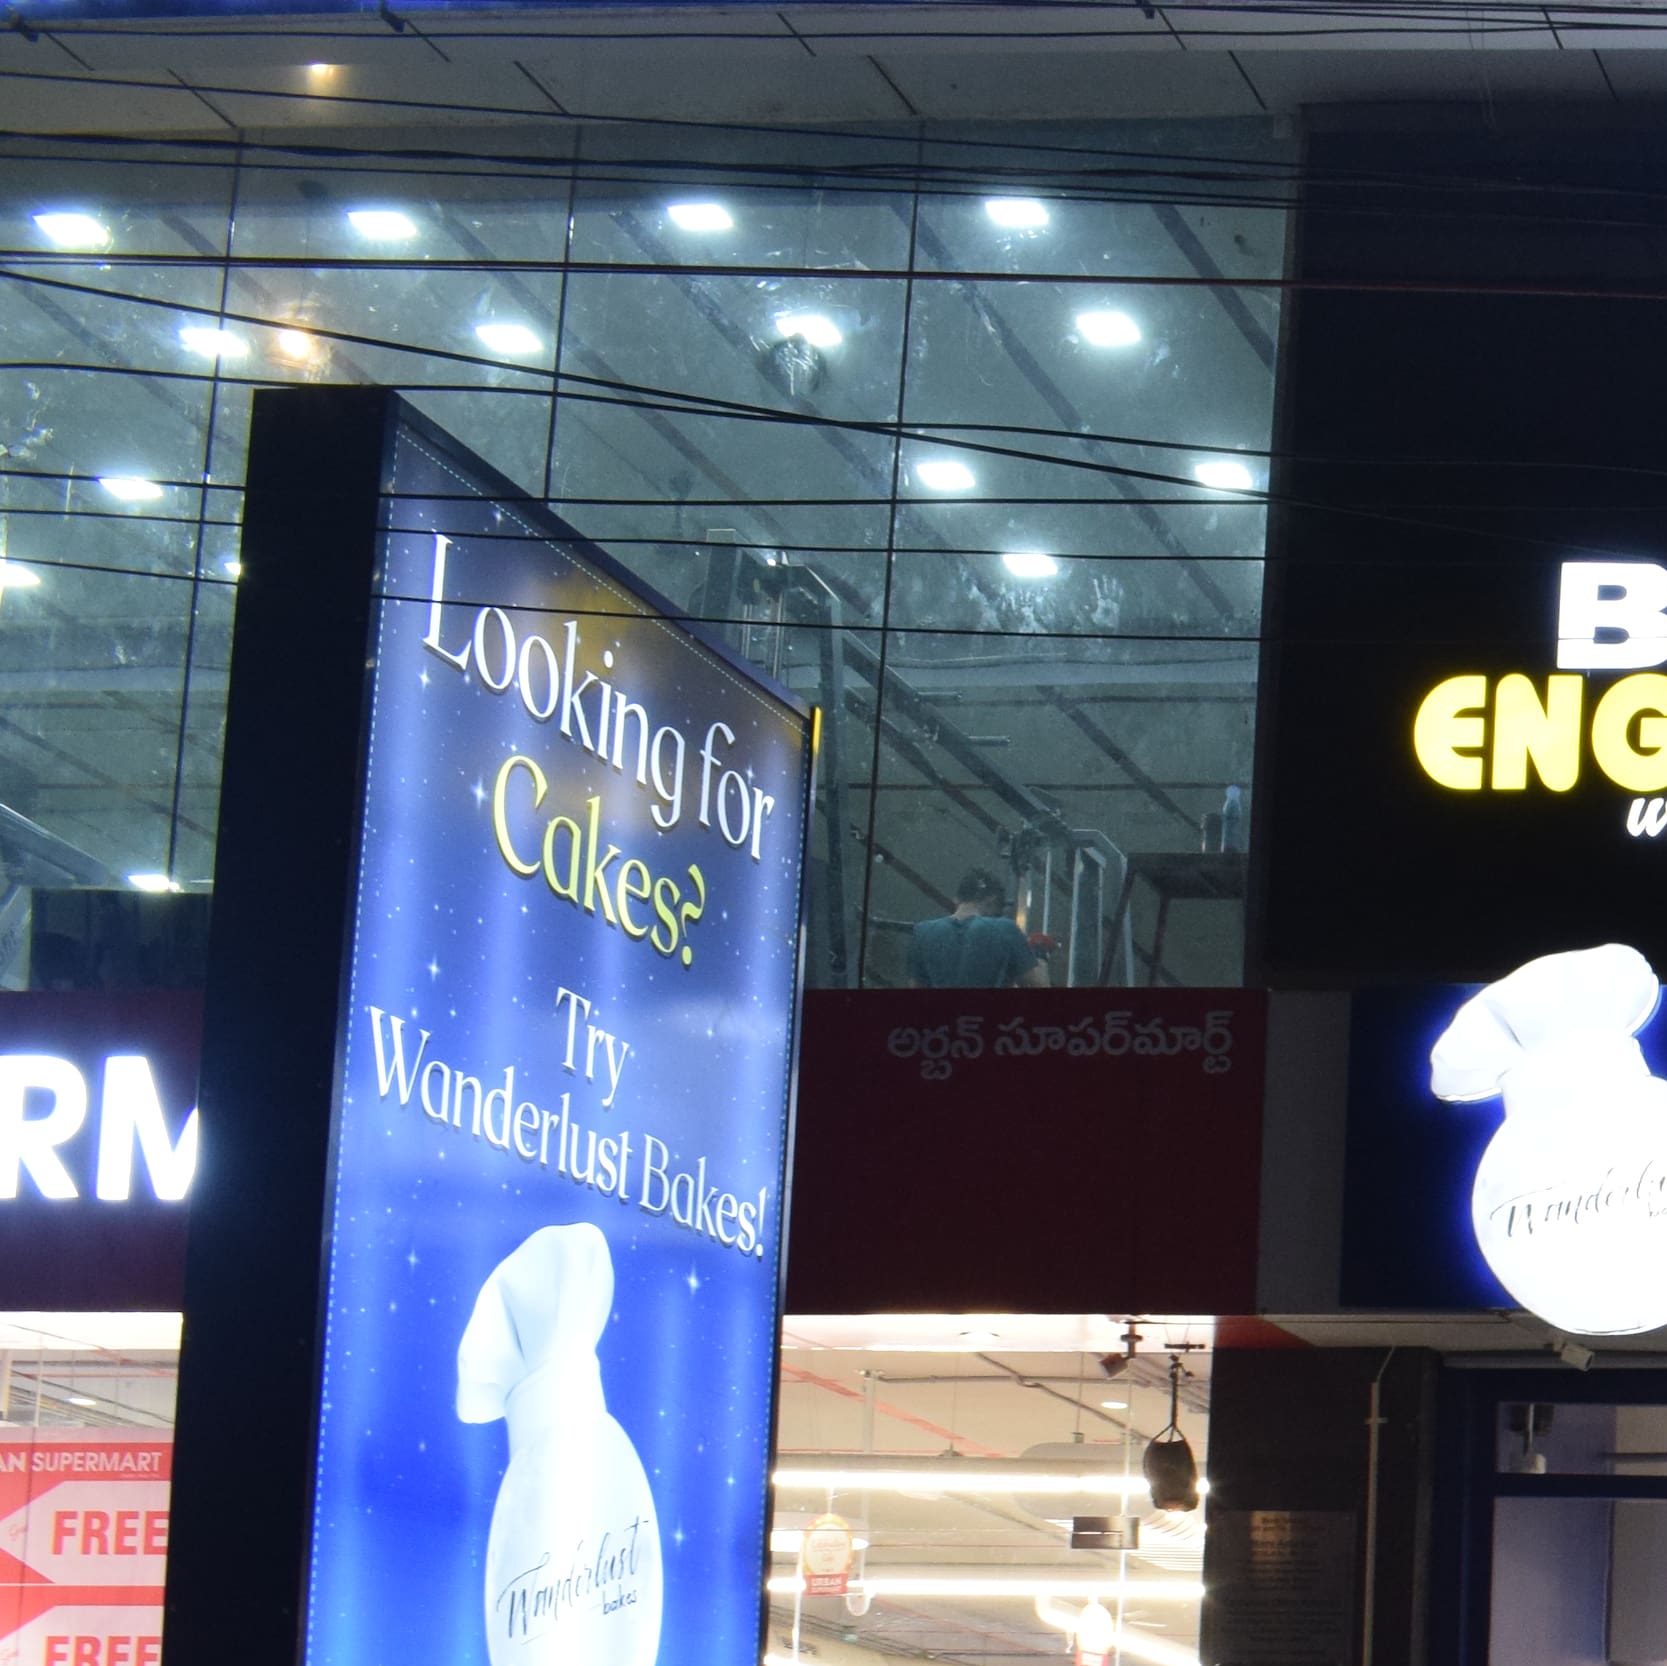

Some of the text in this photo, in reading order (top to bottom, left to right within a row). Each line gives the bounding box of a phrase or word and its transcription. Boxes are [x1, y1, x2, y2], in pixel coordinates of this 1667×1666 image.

[422, 531, 775, 862] Looking for
[491, 755, 706, 967] Cakes?
[556, 987, 630, 1108] Try
[369, 1006, 766, 1258] Wanderlust Bakes!
[32, 1451, 162, 1473] SUPERMART
[52, 1510, 169, 1556] FREE
[494, 1519, 650, 1641] Wanderlust bakes
